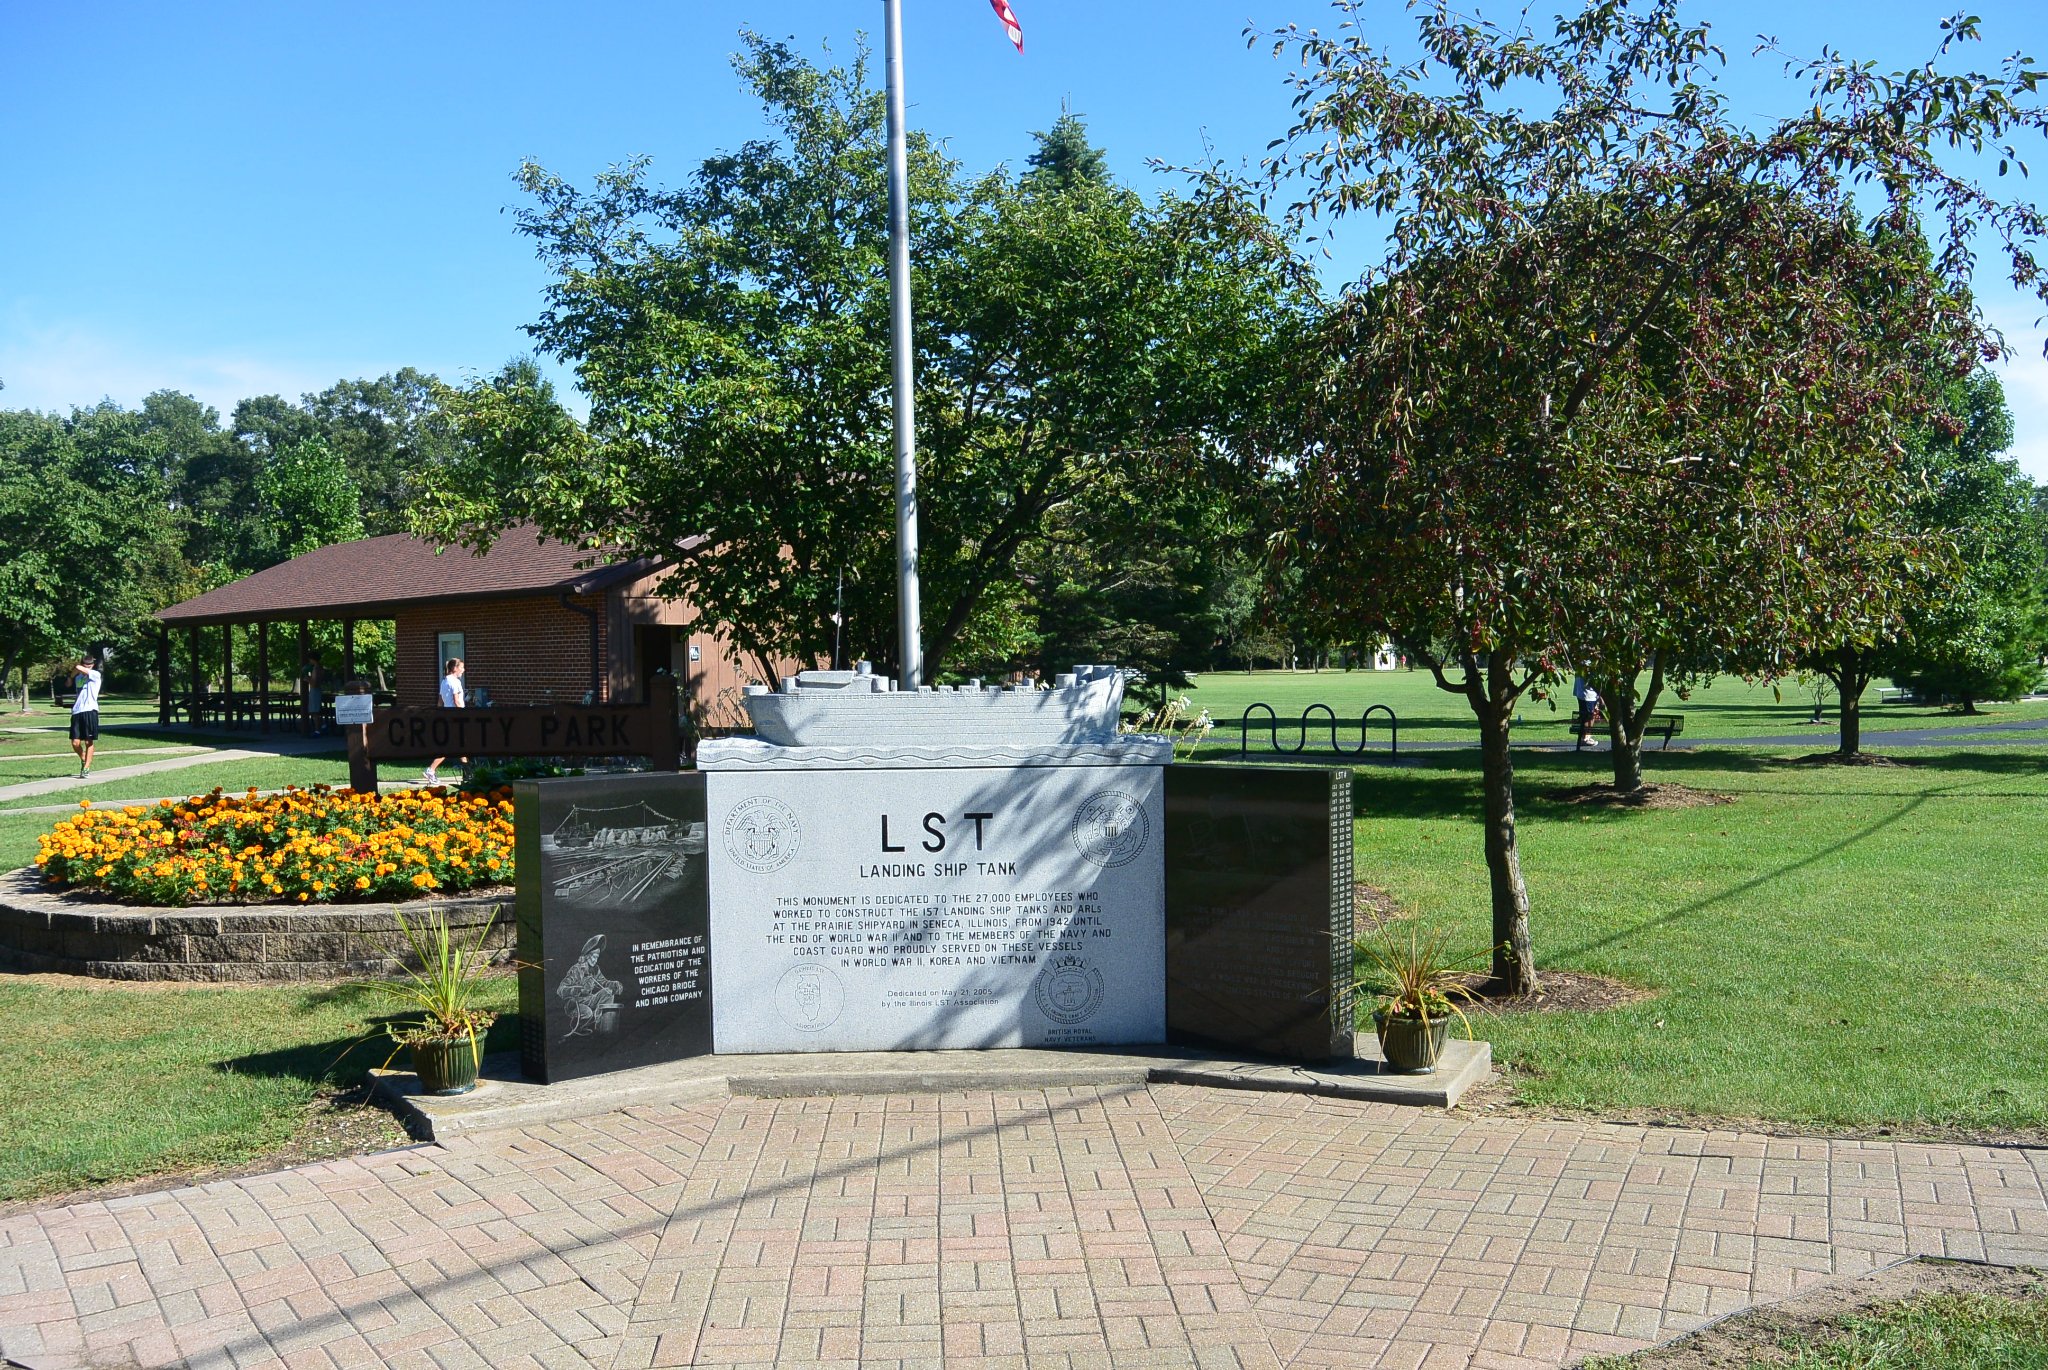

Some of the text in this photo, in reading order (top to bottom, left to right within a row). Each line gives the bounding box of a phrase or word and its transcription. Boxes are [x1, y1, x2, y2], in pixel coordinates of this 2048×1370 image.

[388, 714, 630, 748] CROTTY PARK
[725, 799, 758, 835] DEPARTMENT
[774, 801, 785, 811] THE
[787, 812, 799, 833] NAVY
[881, 812, 993, 853] LST
[860, 862, 1017, 878] LANDING SHIP TANK
[776, 892, 1098, 906] THIS MONUMENT IS DEDICATED TO THE 27,000 EMPLOYEES WHO
[773, 910, 812, 919] WORKED
[818, 909, 830, 918] TO
[836, 908, 894, 918] CONSTRUCT
[900, 908, 918, 917] THE
[923, 908, 938, 916] 157
[944, 906, 985, 916] LANDING
[991, 906, 1011, 915] SHIP
[1017, 905, 1048, 914] TANKS
[1054, 905, 1072, 914] AND
[773, 916, 1102, 931] AT THE PRAIRIE SHIPYARD IN SENECA, ILLINOIS, FROM 1942 UNTIL
[632, 935, 702, 952] IN REMEMBRANCE OF
[766, 929, 1111, 944] THE END OF WORLD WAR II AND TO THE MEMBERS OF THE NAVY AND
[630, 946, 705, 963] THE PATRIOTISM AND
[793, 941, 1083, 956] COAST GUARD WHO PROUDLY SERVED ON THESE VESSELS
[634, 958, 702, 975] DEDICATION OF THE
[841, 959, 849, 967] IN
[854, 958, 887, 967] WORLD
[891, 958, 912, 966] WAR
[929, 956, 961, 966] KOREA
[966, 956, 986, 965] AND
[991, 955, 1036, 964] VIETNAM
[639, 969, 699, 985] WORKERS OF THE
[641, 980, 696, 996] CHICAGO BRIDGE
[941, 989, 957, 997] May
[973, 988, 992, 996] 2005
[635, 990, 703, 1008] AND IRON COMPANY
[881, 1000, 891, 1008] by
[953, 998, 999, 1006] Association
